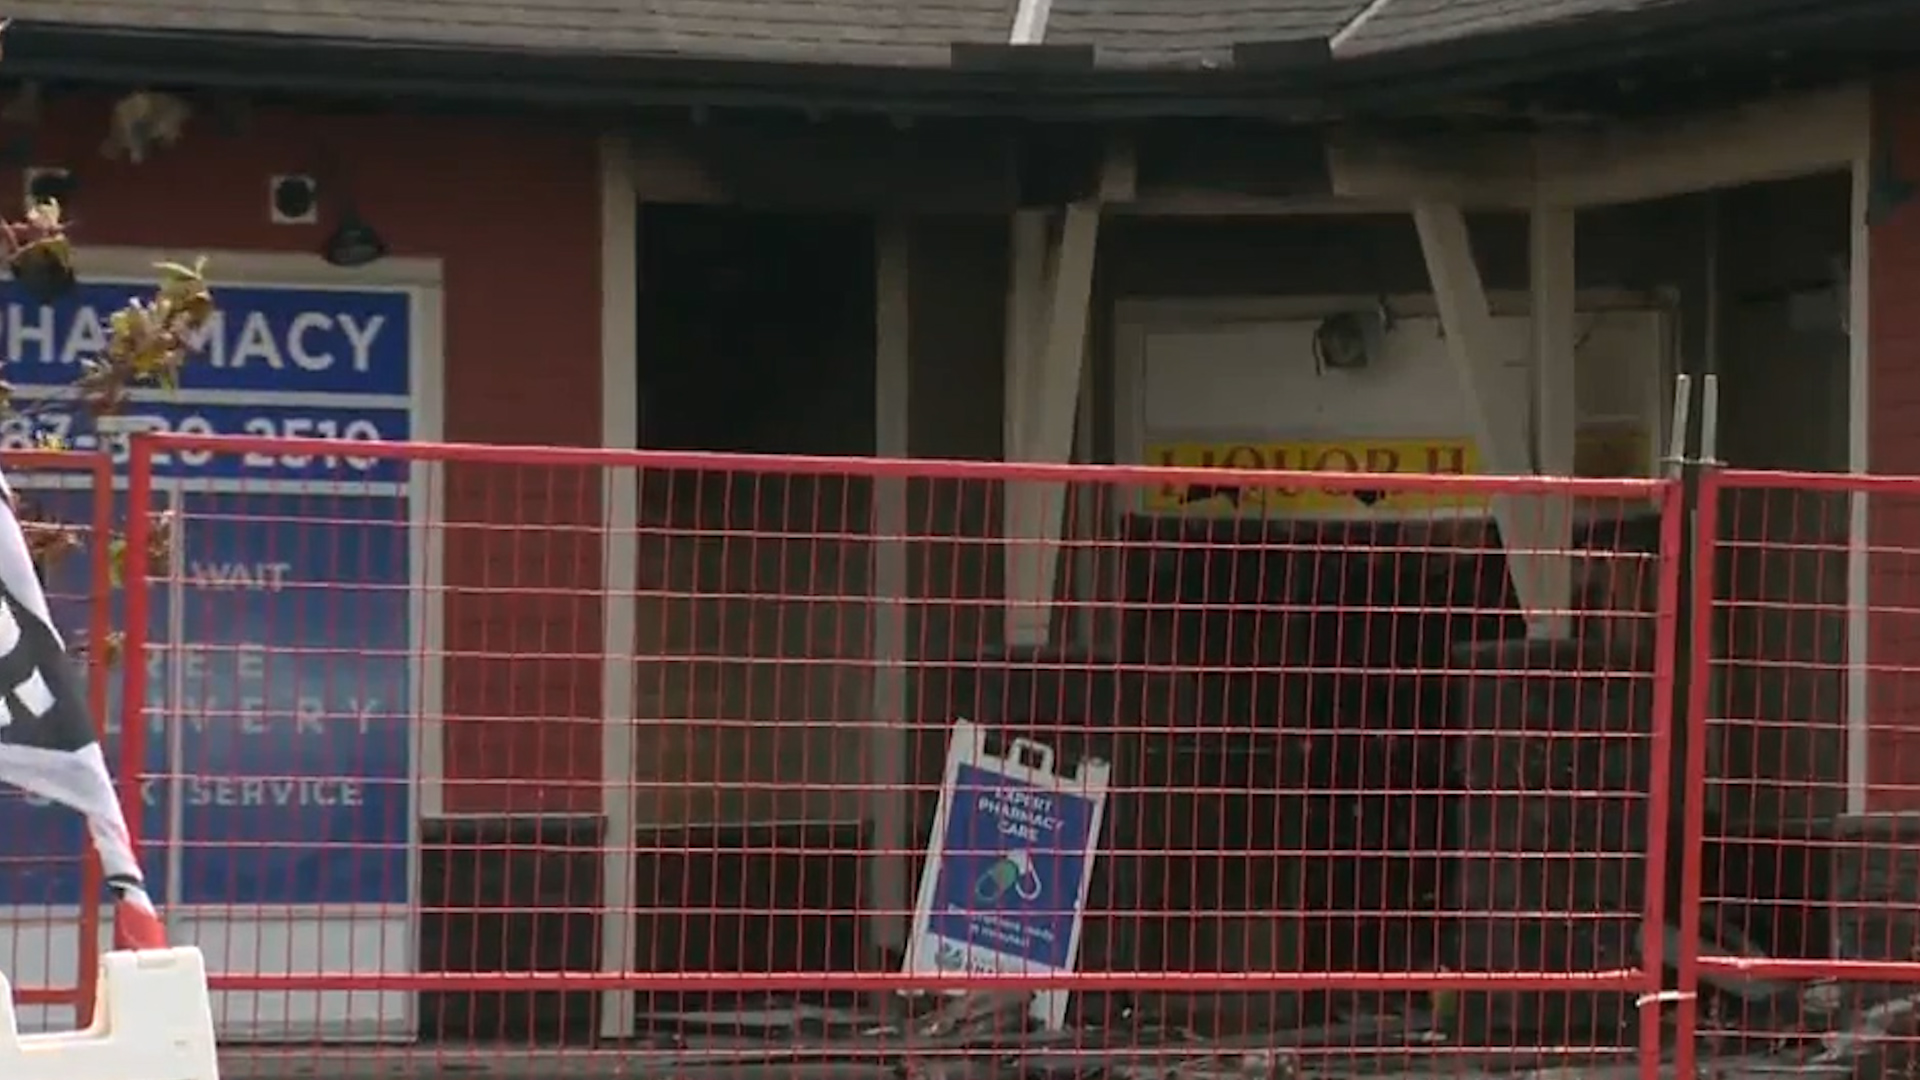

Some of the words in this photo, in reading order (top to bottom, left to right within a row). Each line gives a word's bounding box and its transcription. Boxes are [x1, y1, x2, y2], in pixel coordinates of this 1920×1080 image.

[0, 302, 384, 371] HAMACY
[190, 562, 291, 592] WAIT
[103, 694, 378, 735] LIVERY
[189, 779, 364, 806] SERVICE
[978, 796, 1065, 831] PHARMACY
[997, 820, 1040, 842] CARE
